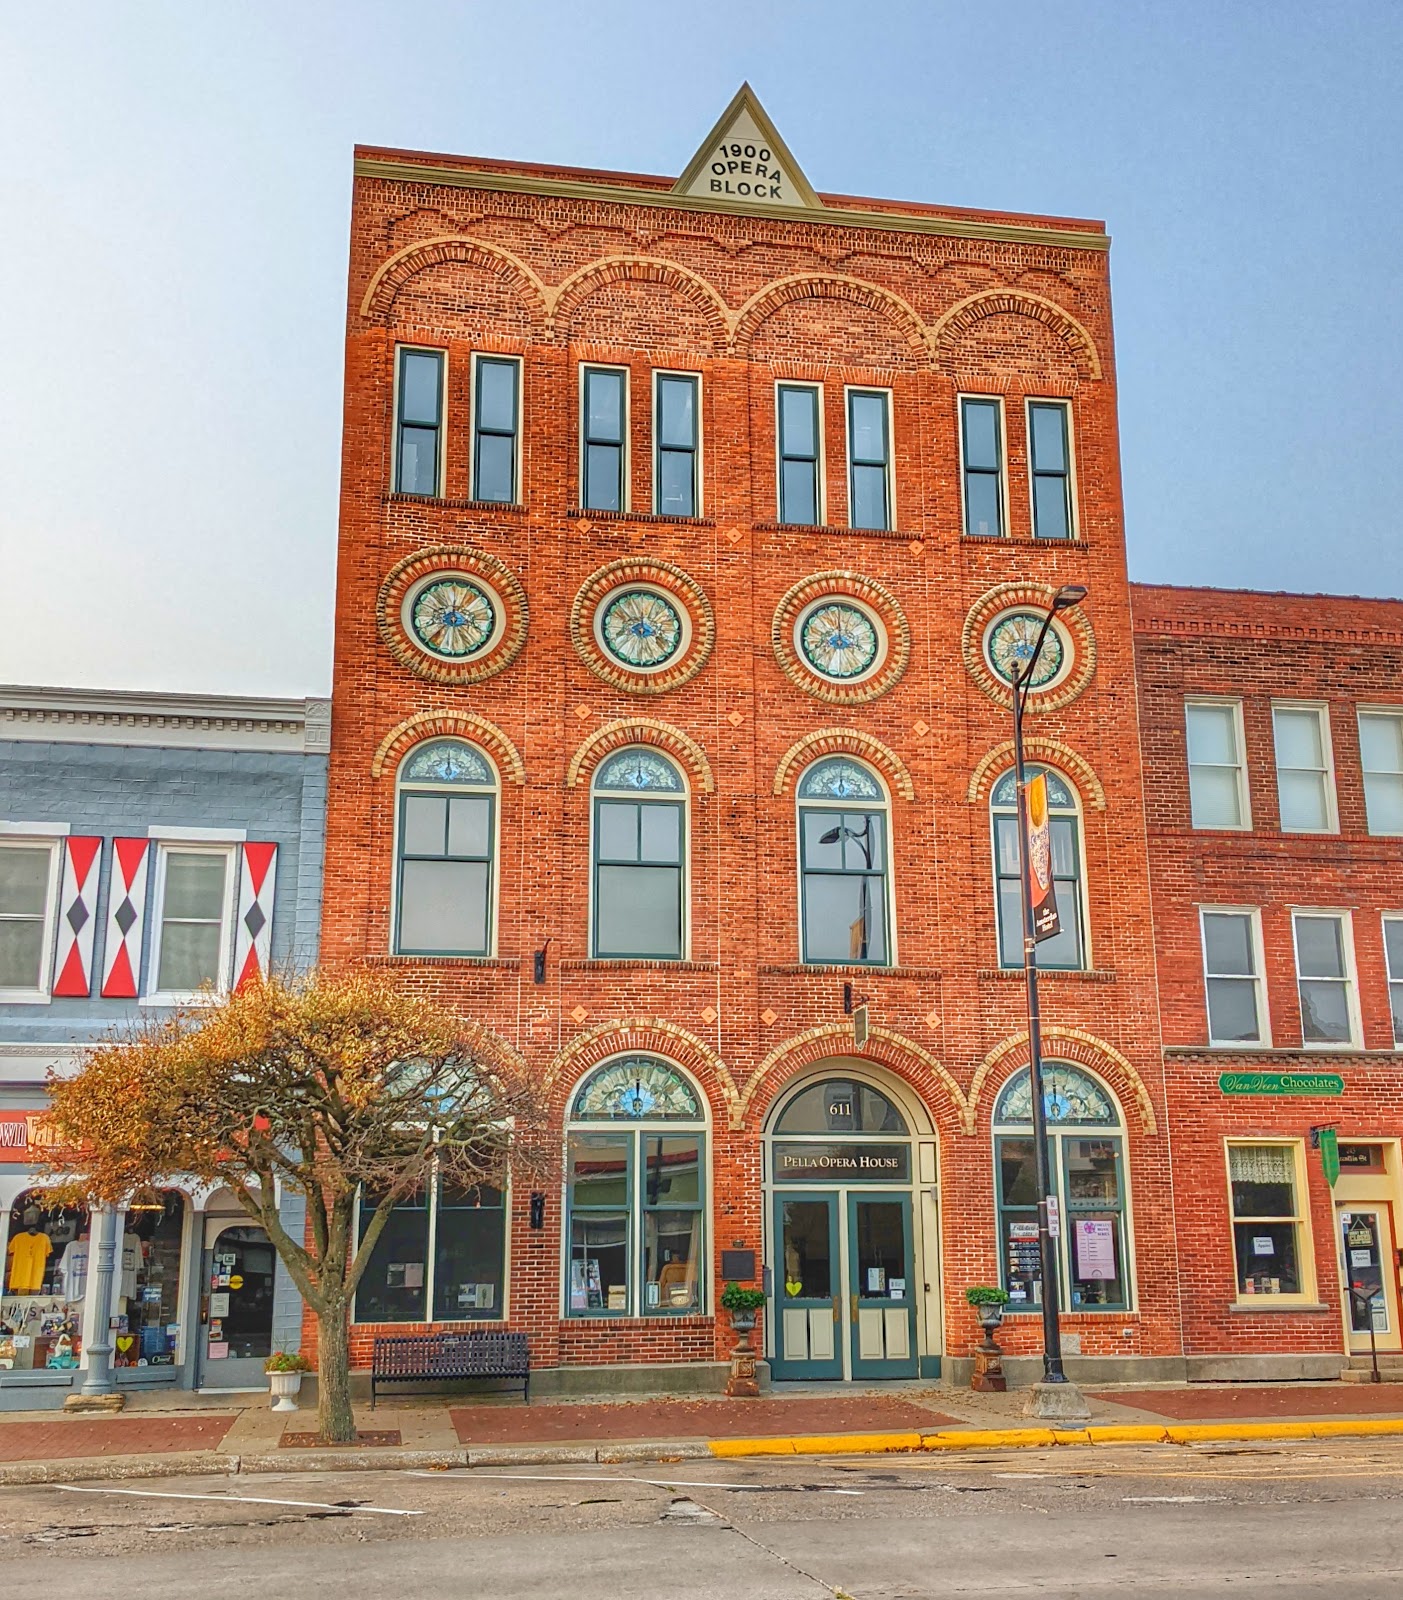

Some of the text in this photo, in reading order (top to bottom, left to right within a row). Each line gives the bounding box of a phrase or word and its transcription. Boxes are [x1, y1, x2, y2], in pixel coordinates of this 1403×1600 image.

[719, 144, 771, 162] 1900
[711, 160, 782, 184] OPERA
[710, 178, 783, 200] BLOCK
[1280, 1076, 1339, 1088] Chocolates
[829, 1102, 852, 1116] 611
